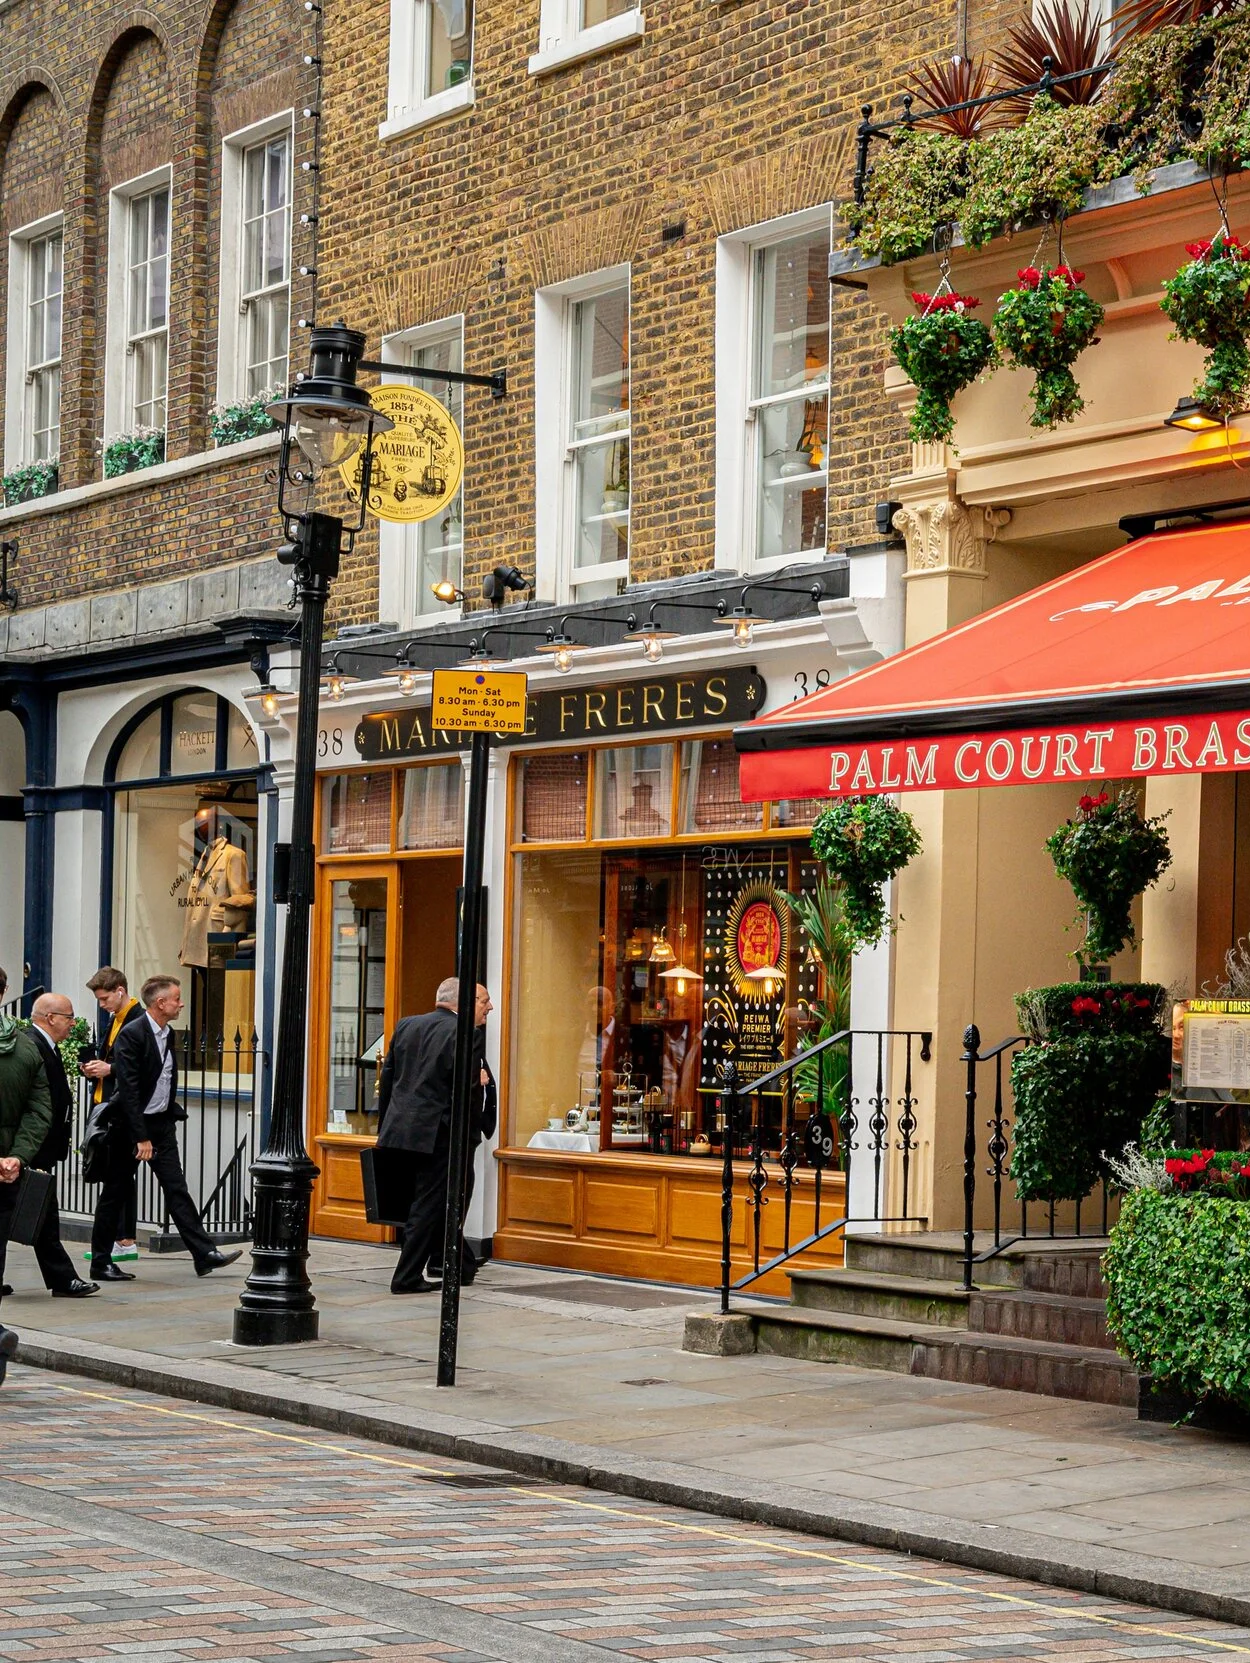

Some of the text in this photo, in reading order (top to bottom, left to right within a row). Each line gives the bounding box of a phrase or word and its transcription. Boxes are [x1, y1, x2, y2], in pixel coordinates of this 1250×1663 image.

[372, 393, 399, 406] MAISON
[424, 402, 434, 412] EN
[390, 401, 415, 412] 1854
[379, 441, 426, 459] MARIAGE
[458, 686, 478, 695] Mon
[485, 687, 501, 696] Sat
[438, 696, 461, 705] 8.30
[462, 698, 476, 706] am
[483, 698, 505, 707] 6.30
[506, 700, 520, 708] pm
[560, 677, 728, 733] FRERES
[462, 708, 496, 718] Sunday
[435, 717, 462, 726] 10.30
[463, 719, 477, 727] am
[484, 719, 506, 728] 6.30
[507, 721, 521, 729] pm
[179, 730, 215, 748] HACKETT
[318, 727, 343, 757] 38
[187, 747, 207, 756] LONDON
[828, 744, 939, 791] PALM
[954, 729, 1115, 783] COURT
[169, 871, 188, 897] URBAN
[178, 896, 209, 908] RURAL IDYLL
[744, 1014, 770, 1024] REIWA
[742, 1024, 771, 1033] PREMIER
[811, 1124, 834, 1157] 39
